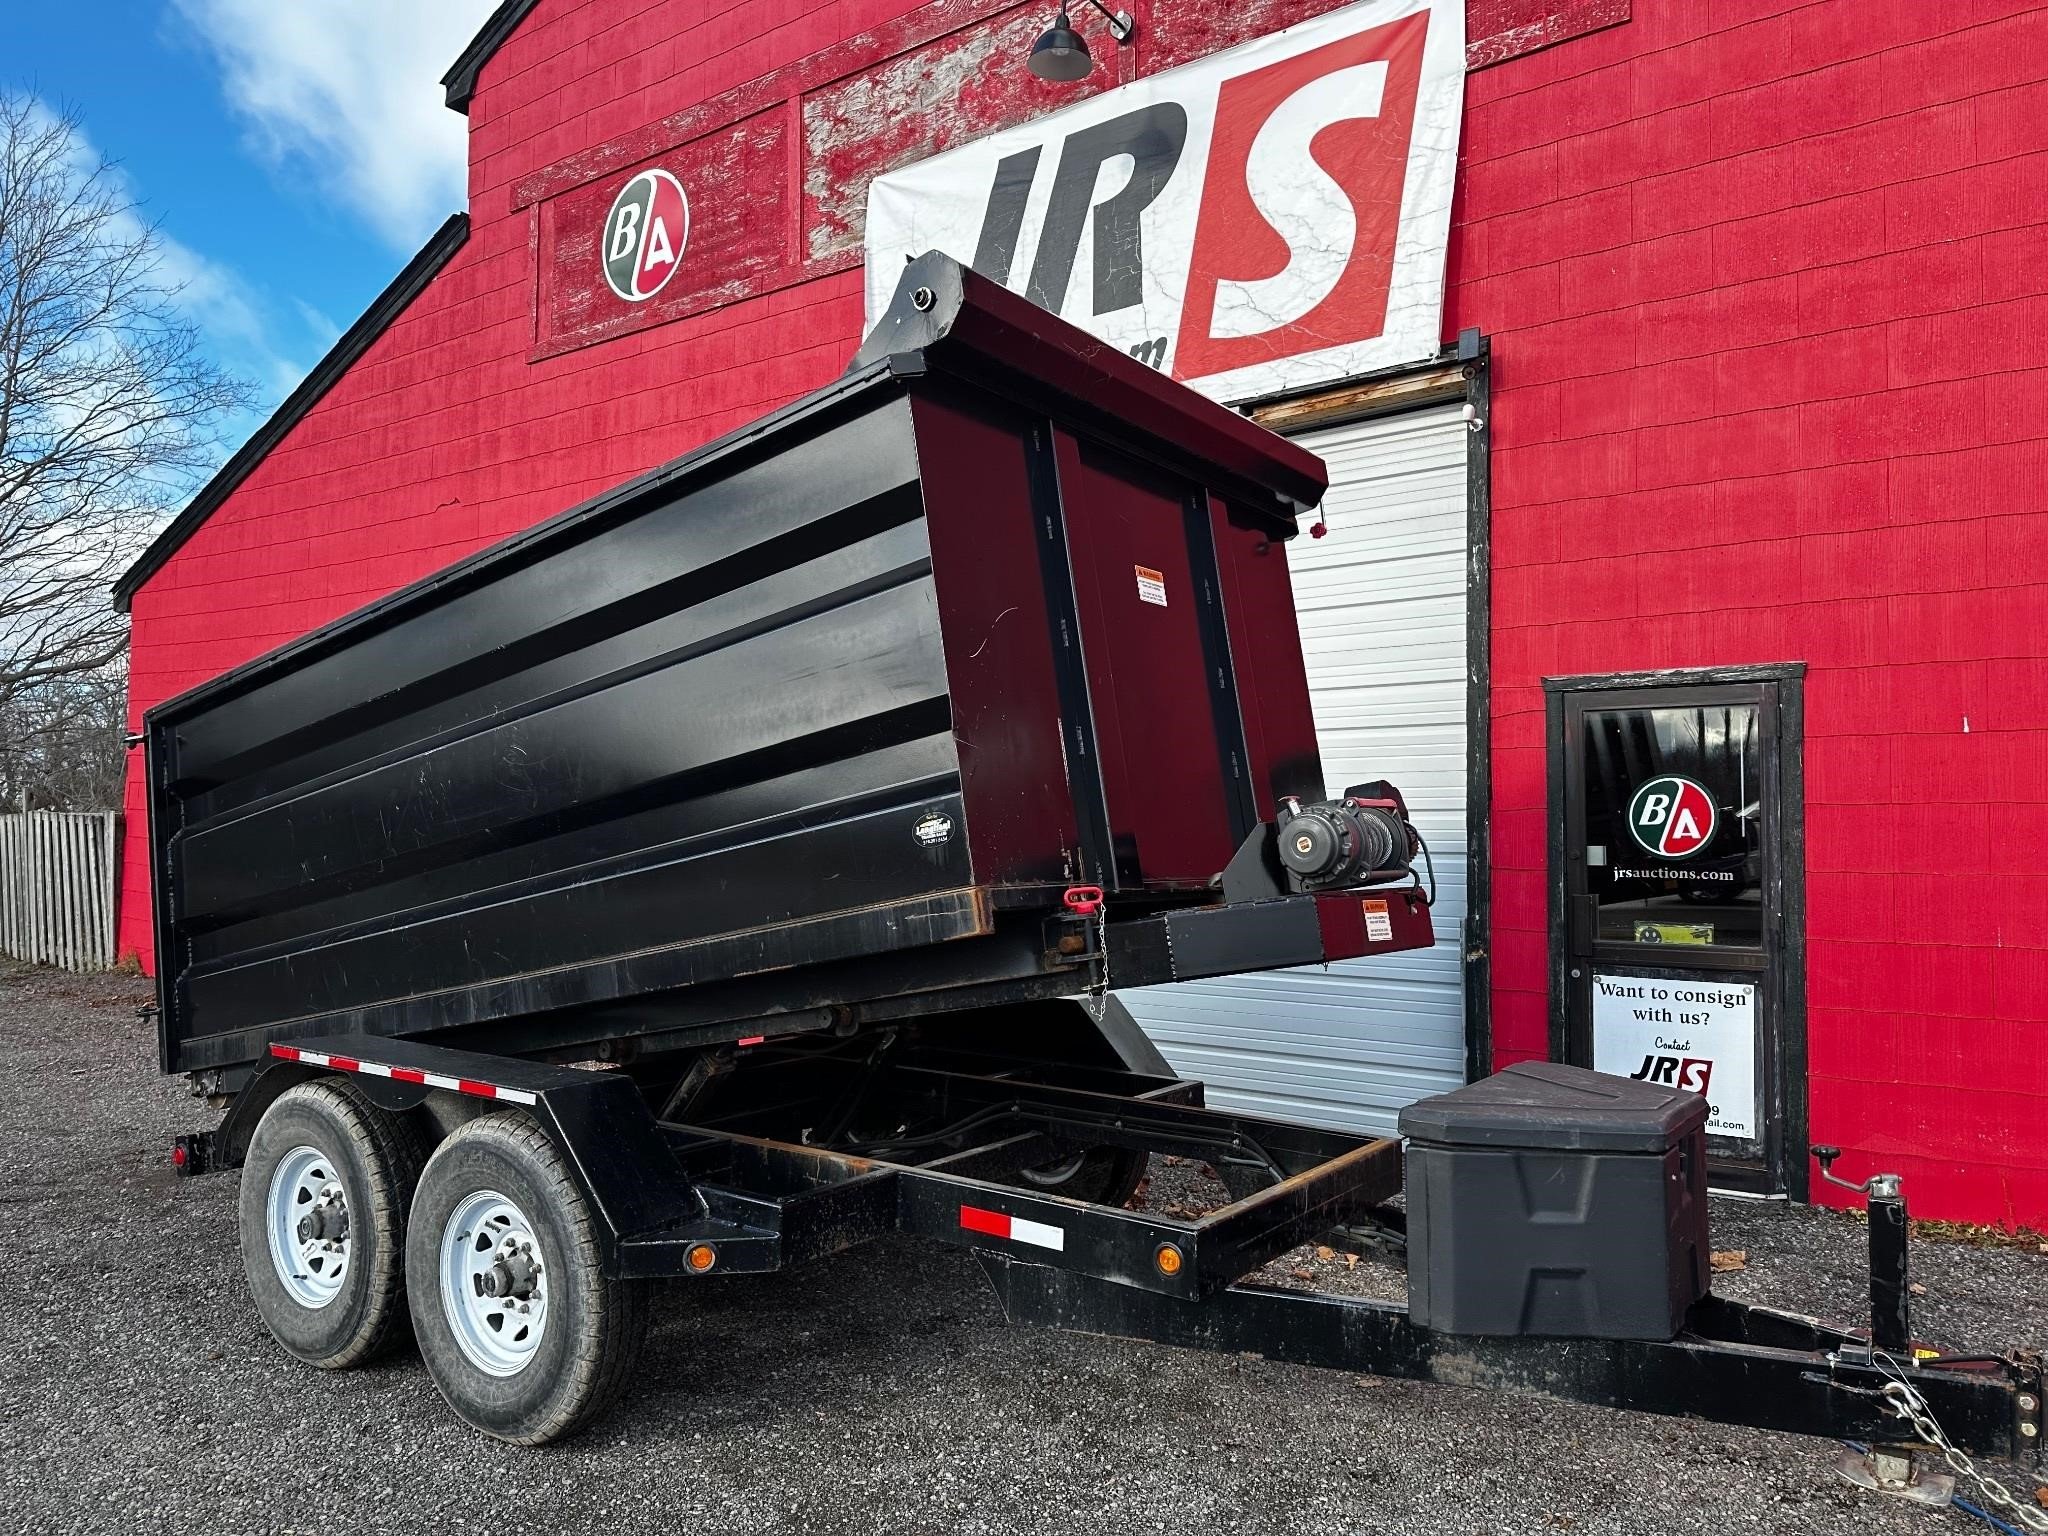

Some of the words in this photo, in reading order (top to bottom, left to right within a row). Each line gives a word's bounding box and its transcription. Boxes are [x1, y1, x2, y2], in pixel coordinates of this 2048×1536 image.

[1613, 866, 1734, 882] jrsauctions.com
[1599, 982, 1646, 999] Want
[1651, 987, 1668, 1000] to
[1674, 989, 1747, 1009] consign
[1632, 1007, 1673, 1023] with
[1679, 1012, 1710, 1026] us?
[1654, 1036, 1691, 1051] Contact
[1630, 1054, 1709, 1094] JRS
